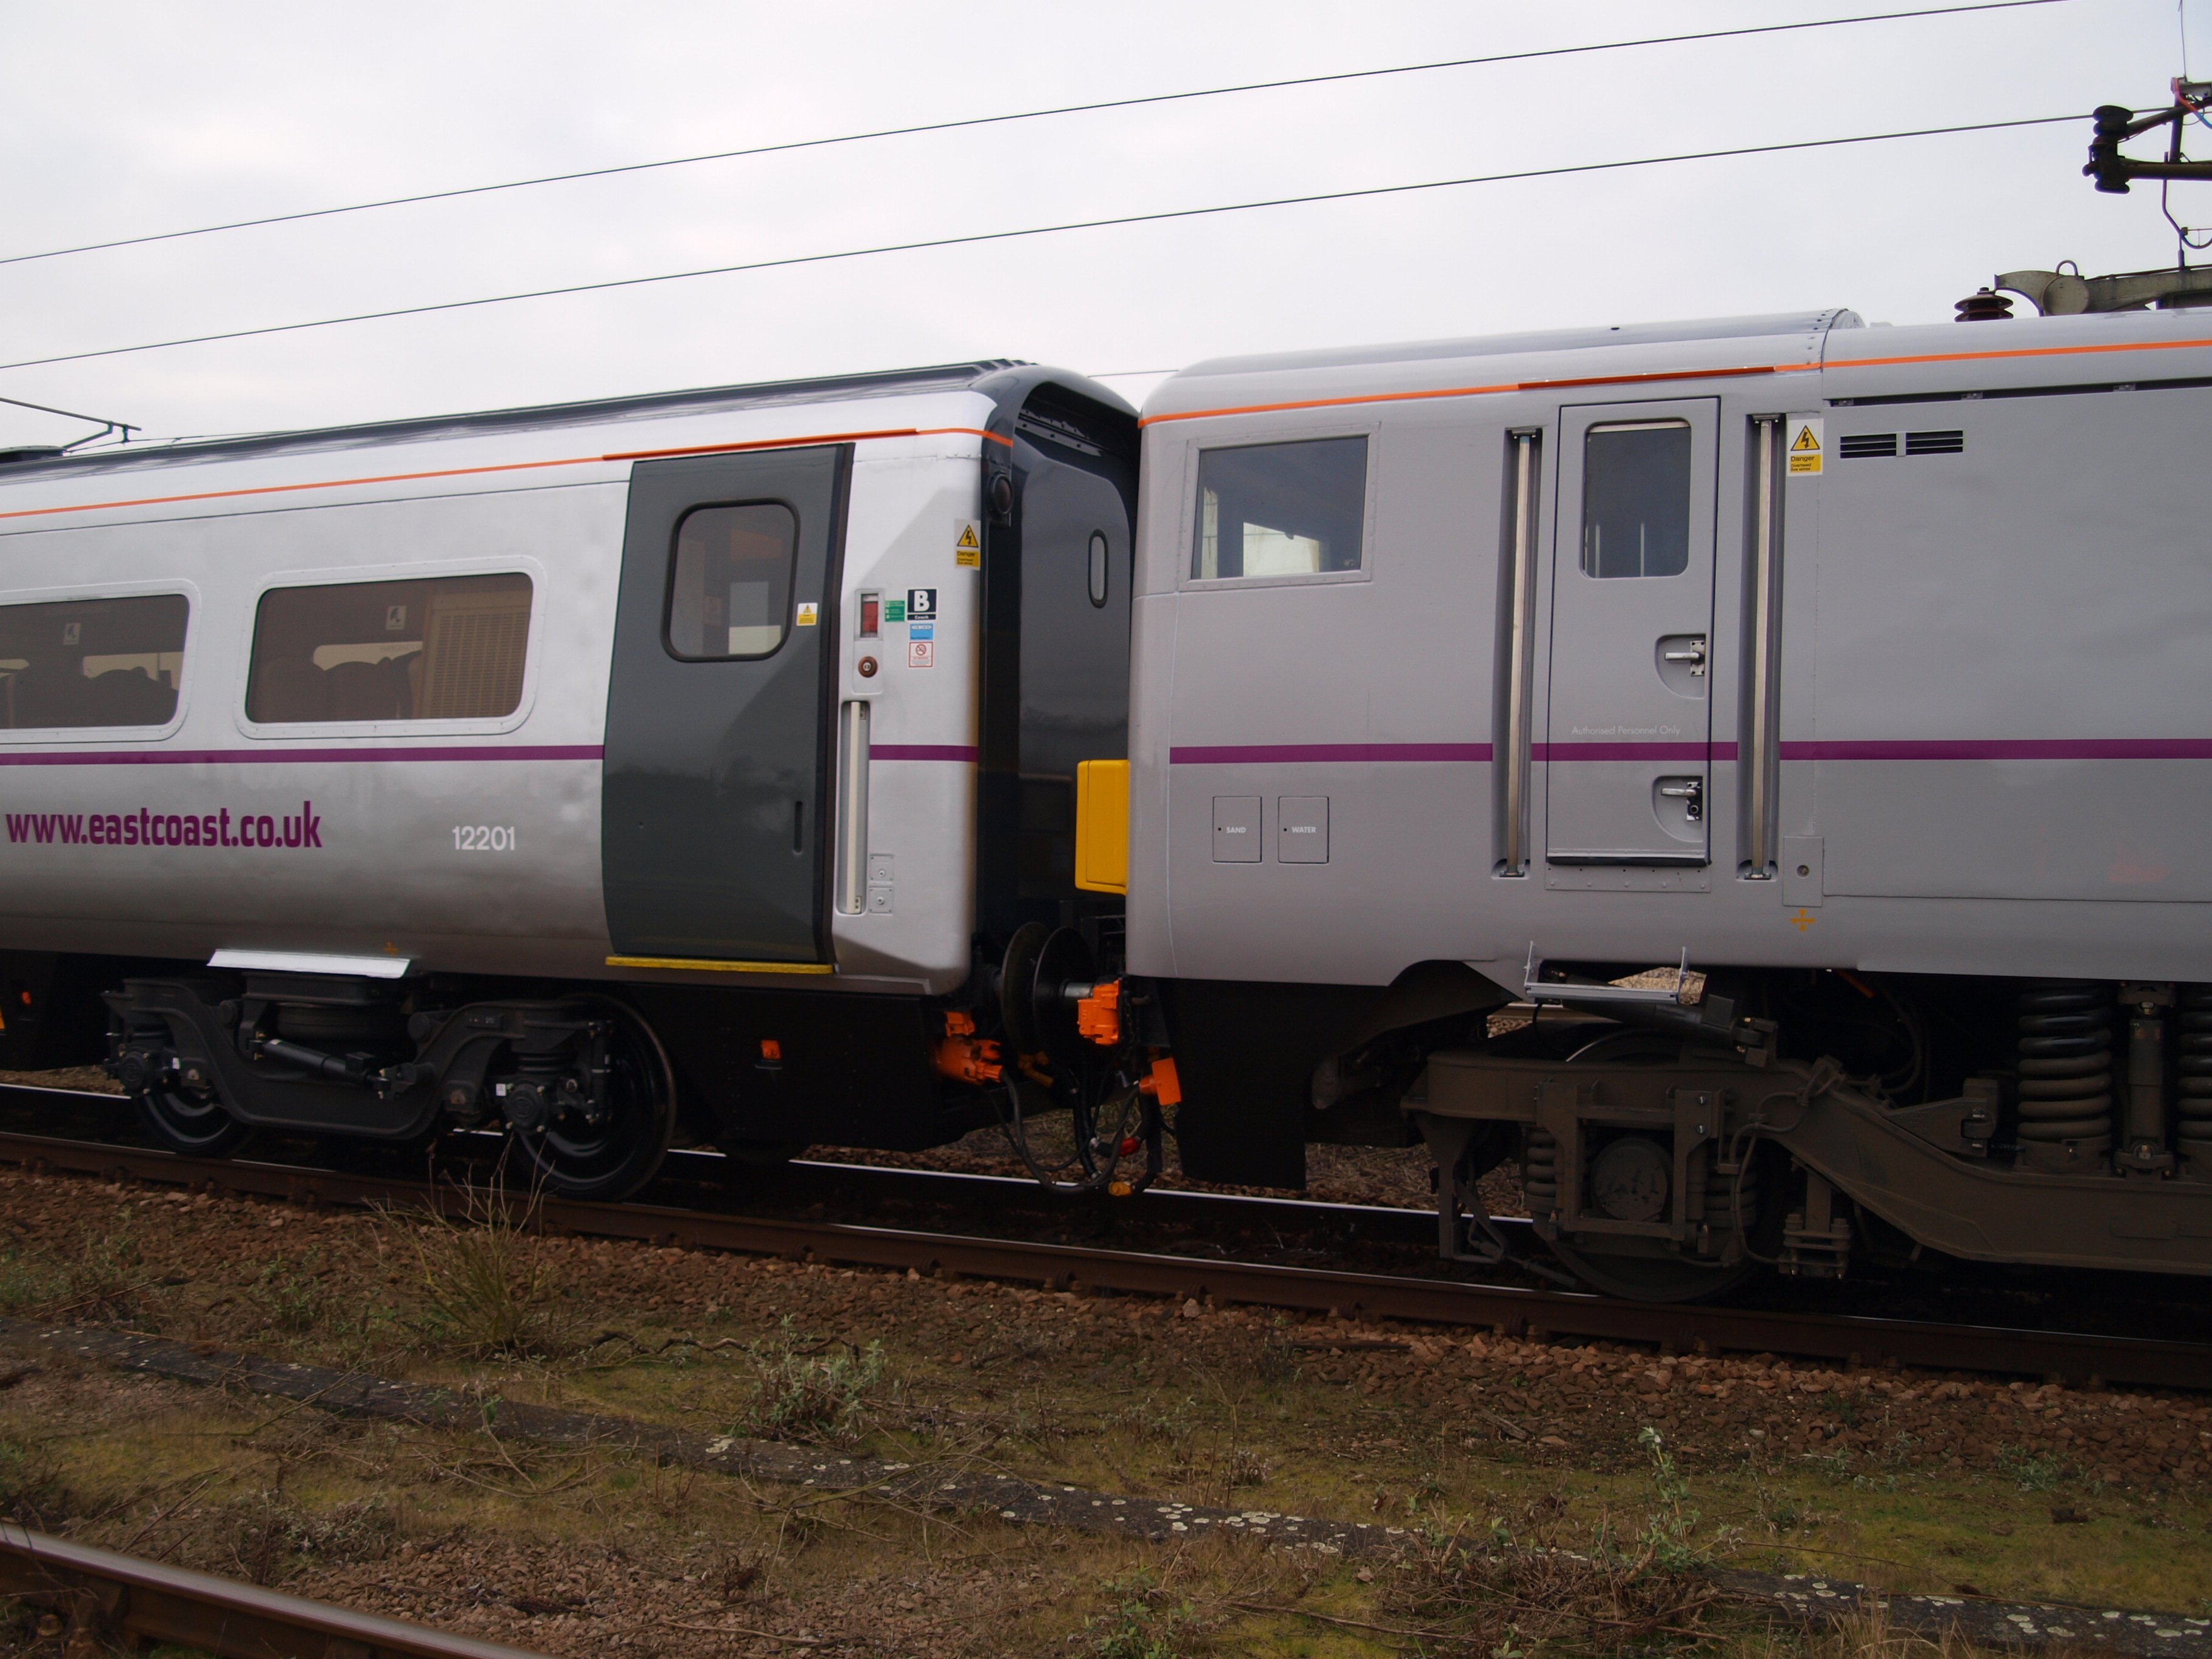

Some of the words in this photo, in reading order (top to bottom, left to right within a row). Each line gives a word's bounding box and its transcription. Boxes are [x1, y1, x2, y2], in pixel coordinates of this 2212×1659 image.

[914, 590, 930, 612] B
[1572, 726, 1615, 735] Authorised
[1618, 725, 1657, 735] Personnel
[1660, 725, 1681, 737] Only
[5, 800, 323, 849] www.eastcoast.co.uk
[452, 826, 516, 851] 12201
